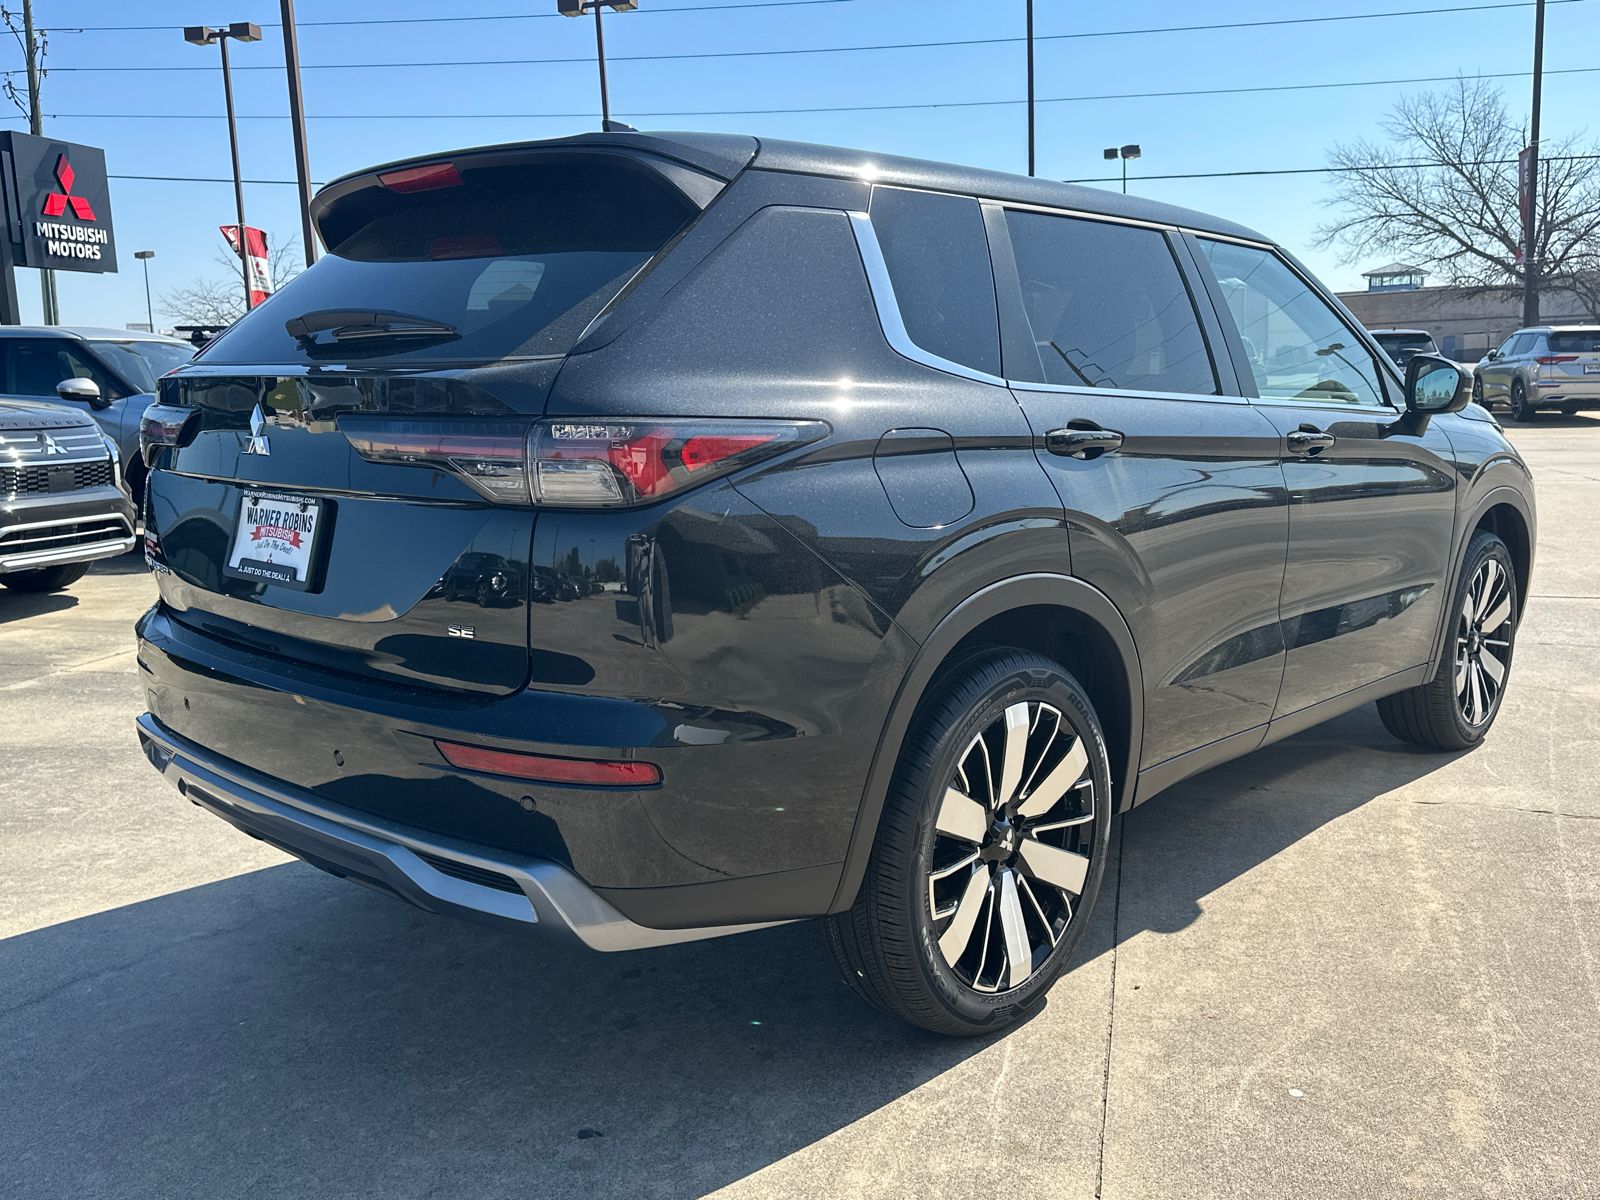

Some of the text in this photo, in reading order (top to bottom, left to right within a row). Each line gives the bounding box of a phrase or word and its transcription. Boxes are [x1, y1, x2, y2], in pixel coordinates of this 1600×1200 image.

[36, 222, 108, 244] MITSUBISHI
[48, 240, 102, 260] MOTORS
[247, 506, 313, 533] WARNER ROBINS
[260, 526, 295, 541] MITSUBISHI
[243, 566, 254, 575] JUST
[261, 570, 272, 578] THE
[447, 624, 475, 639] SE
[919, 925, 959, 1006] NEXEN
